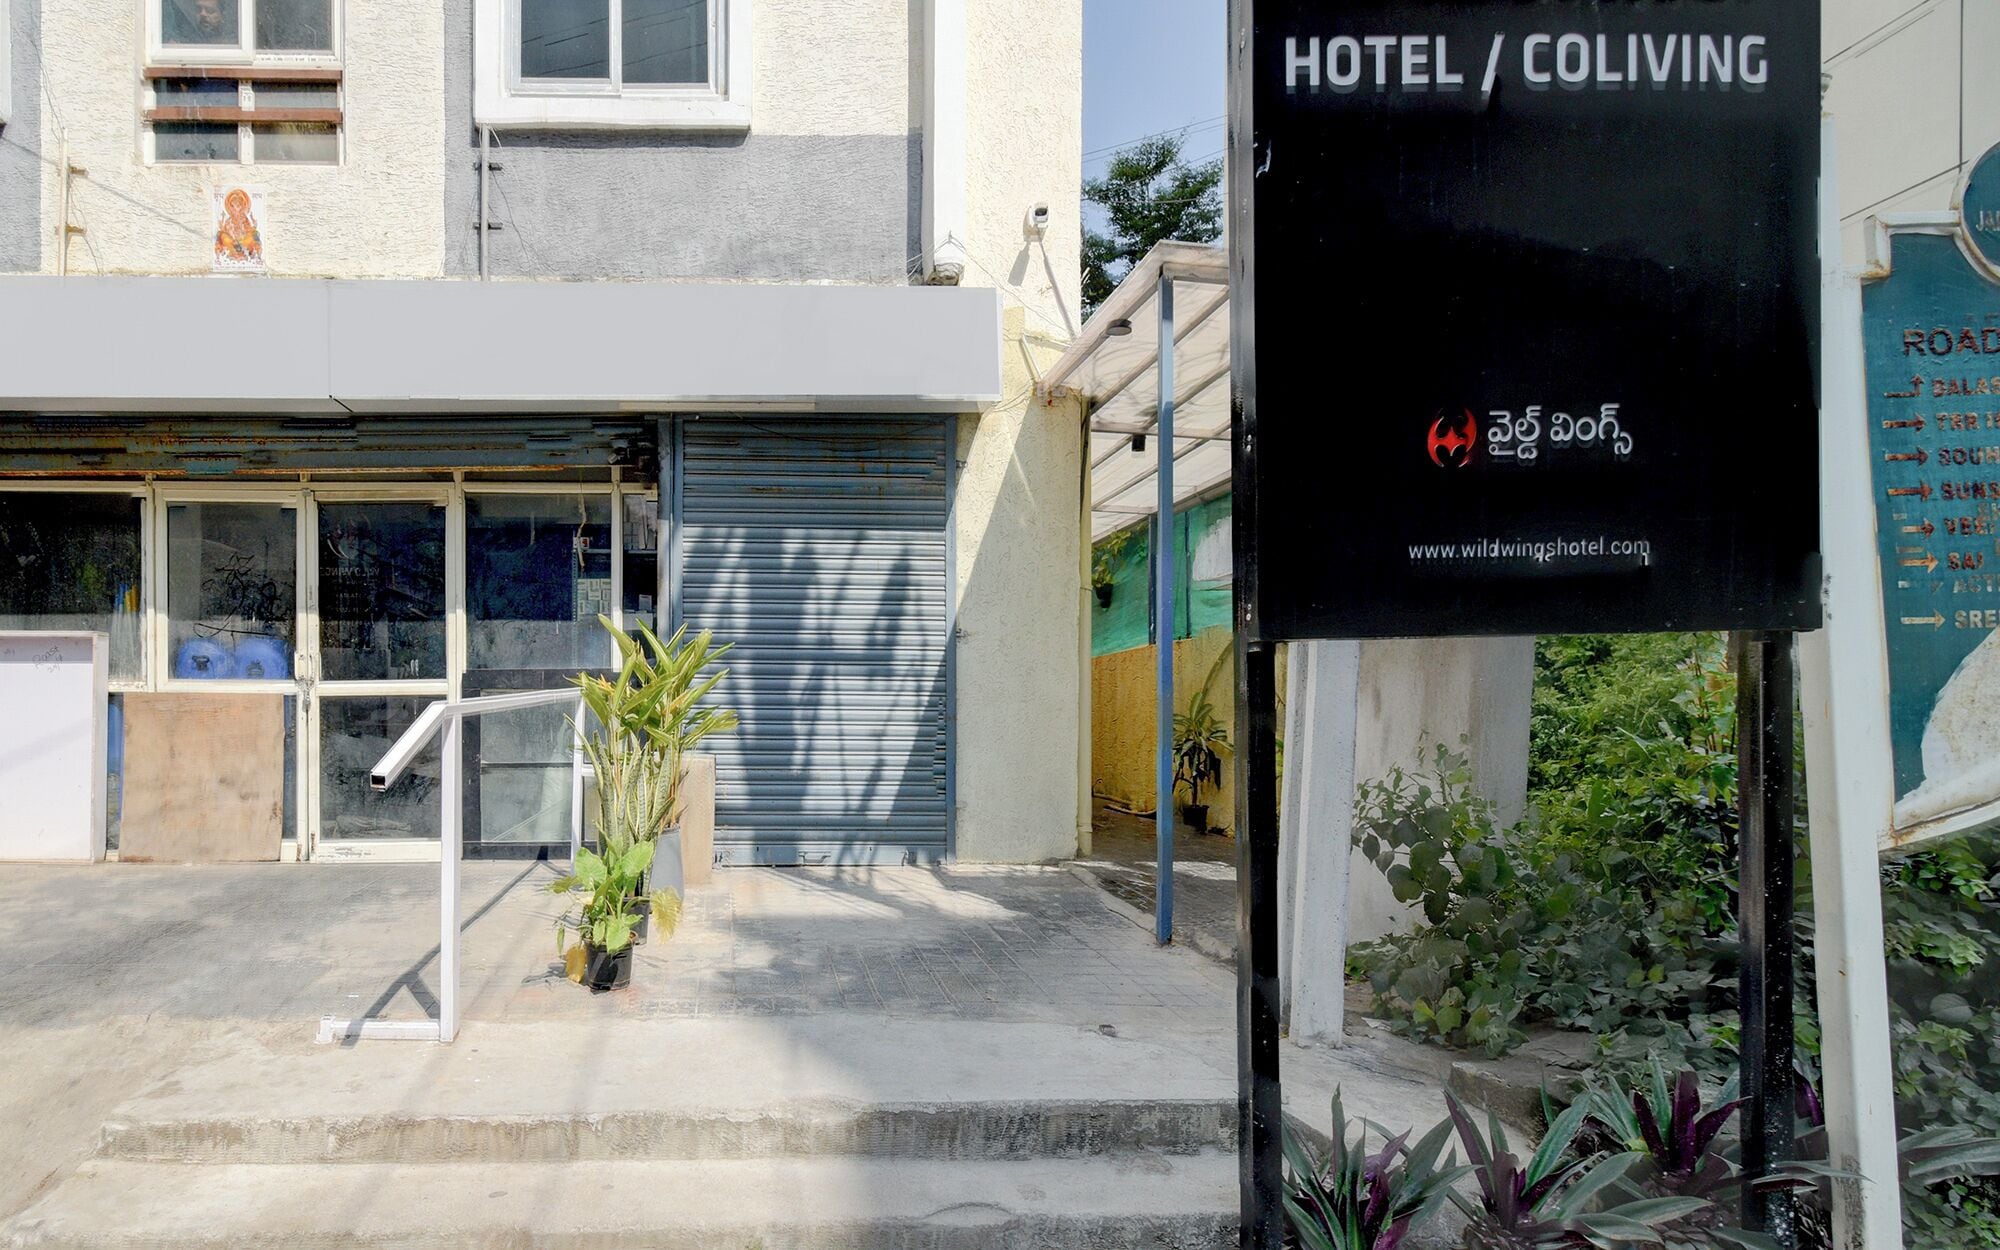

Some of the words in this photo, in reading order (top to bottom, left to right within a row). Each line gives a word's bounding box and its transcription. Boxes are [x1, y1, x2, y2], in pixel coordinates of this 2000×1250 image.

[1285, 35, 1464, 87] HOTEL
[1481, 31, 1506, 94] /
[1523, 33, 1768, 84] COLIVING
[1903, 327, 2000, 357] ROAD
[1408, 536, 1651, 564] www.wildwingshotel.com
[1954, 609, 2000, 629] SRE
